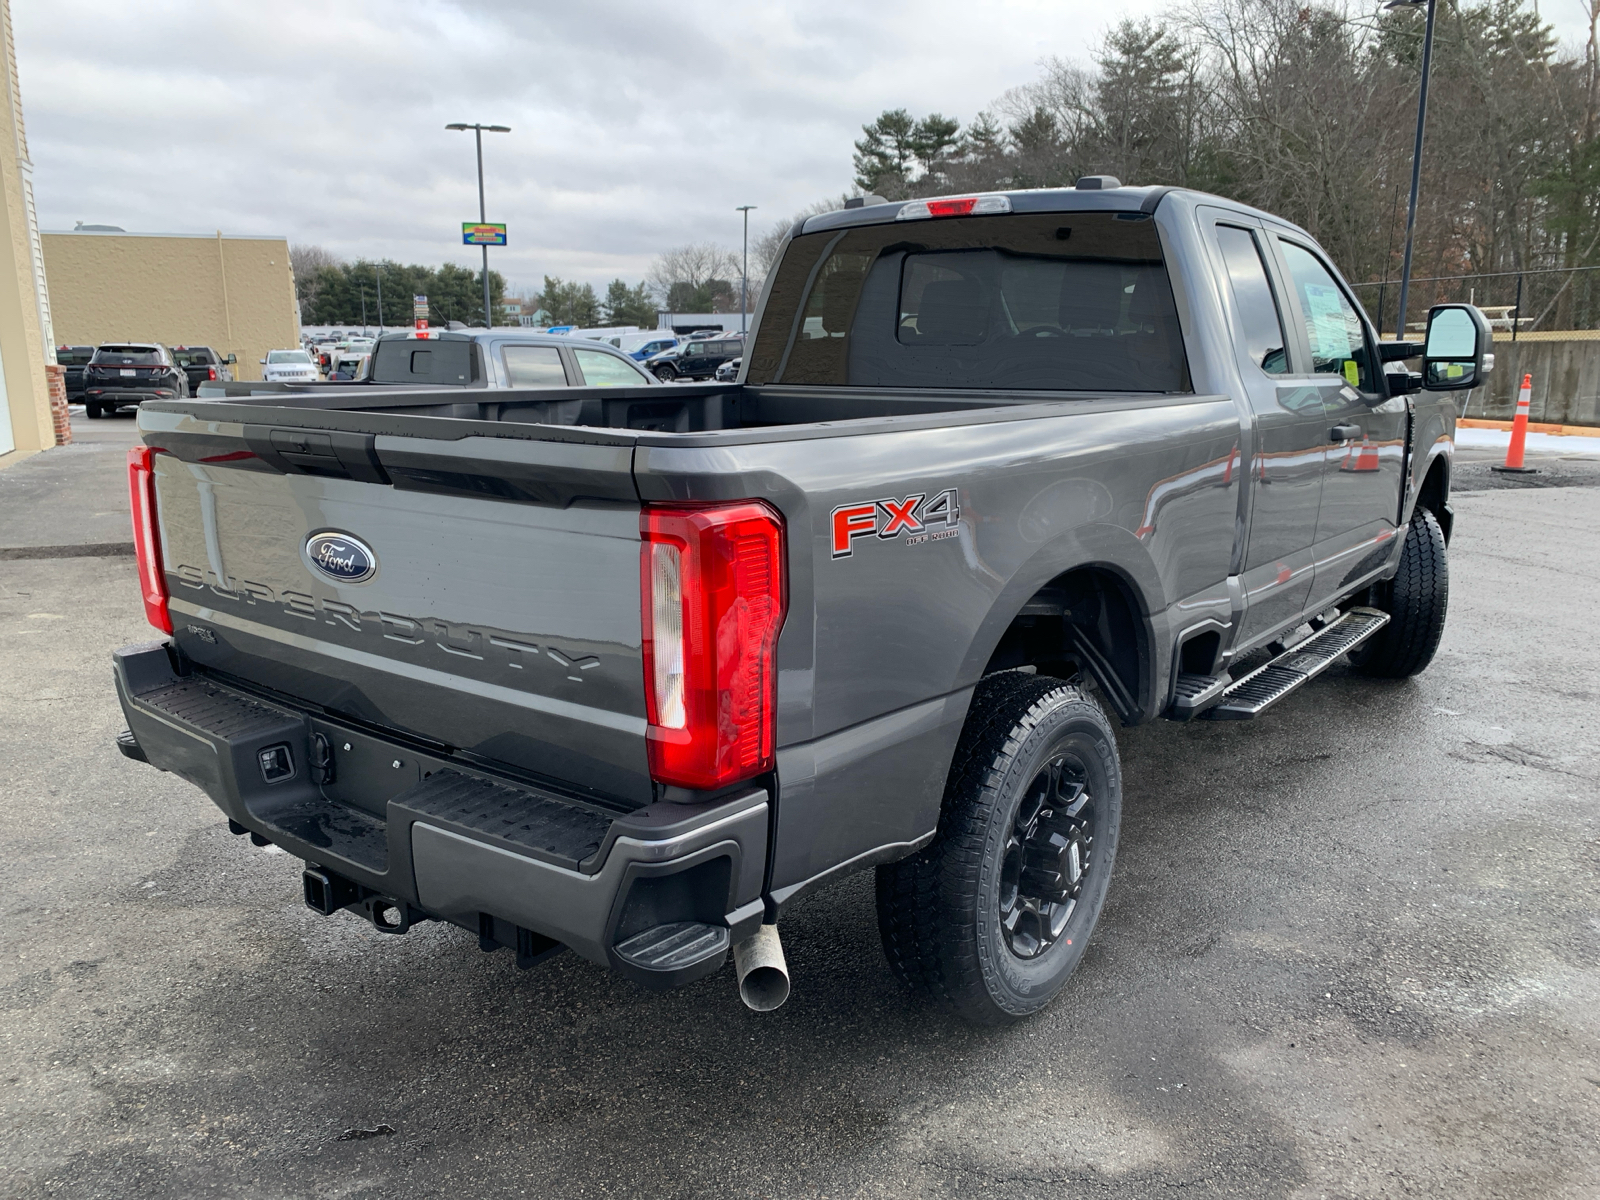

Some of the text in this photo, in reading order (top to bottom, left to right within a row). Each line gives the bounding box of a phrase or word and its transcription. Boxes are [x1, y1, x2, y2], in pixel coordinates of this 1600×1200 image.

[830, 487, 960, 560] FX4
[906, 529, 959, 546] OFF ROAD
[319, 542, 354, 572] Ford
[178, 564, 600, 682] SUPER DUTY
